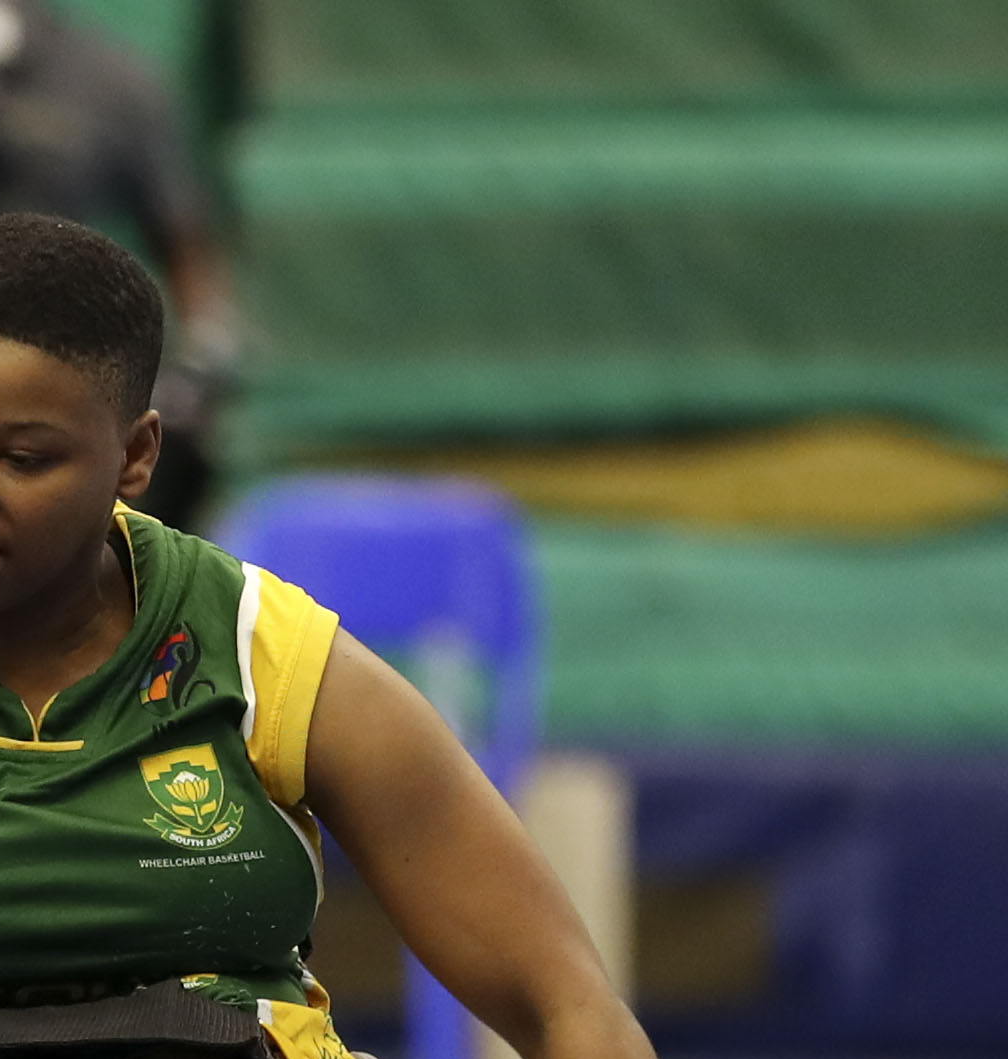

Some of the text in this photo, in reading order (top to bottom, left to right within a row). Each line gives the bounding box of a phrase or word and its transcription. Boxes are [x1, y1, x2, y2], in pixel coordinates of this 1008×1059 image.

[168, 825, 237, 847] SOUTH AFRICA
[138, 849, 266, 869] WHEELCHAIR BASKETBALL
